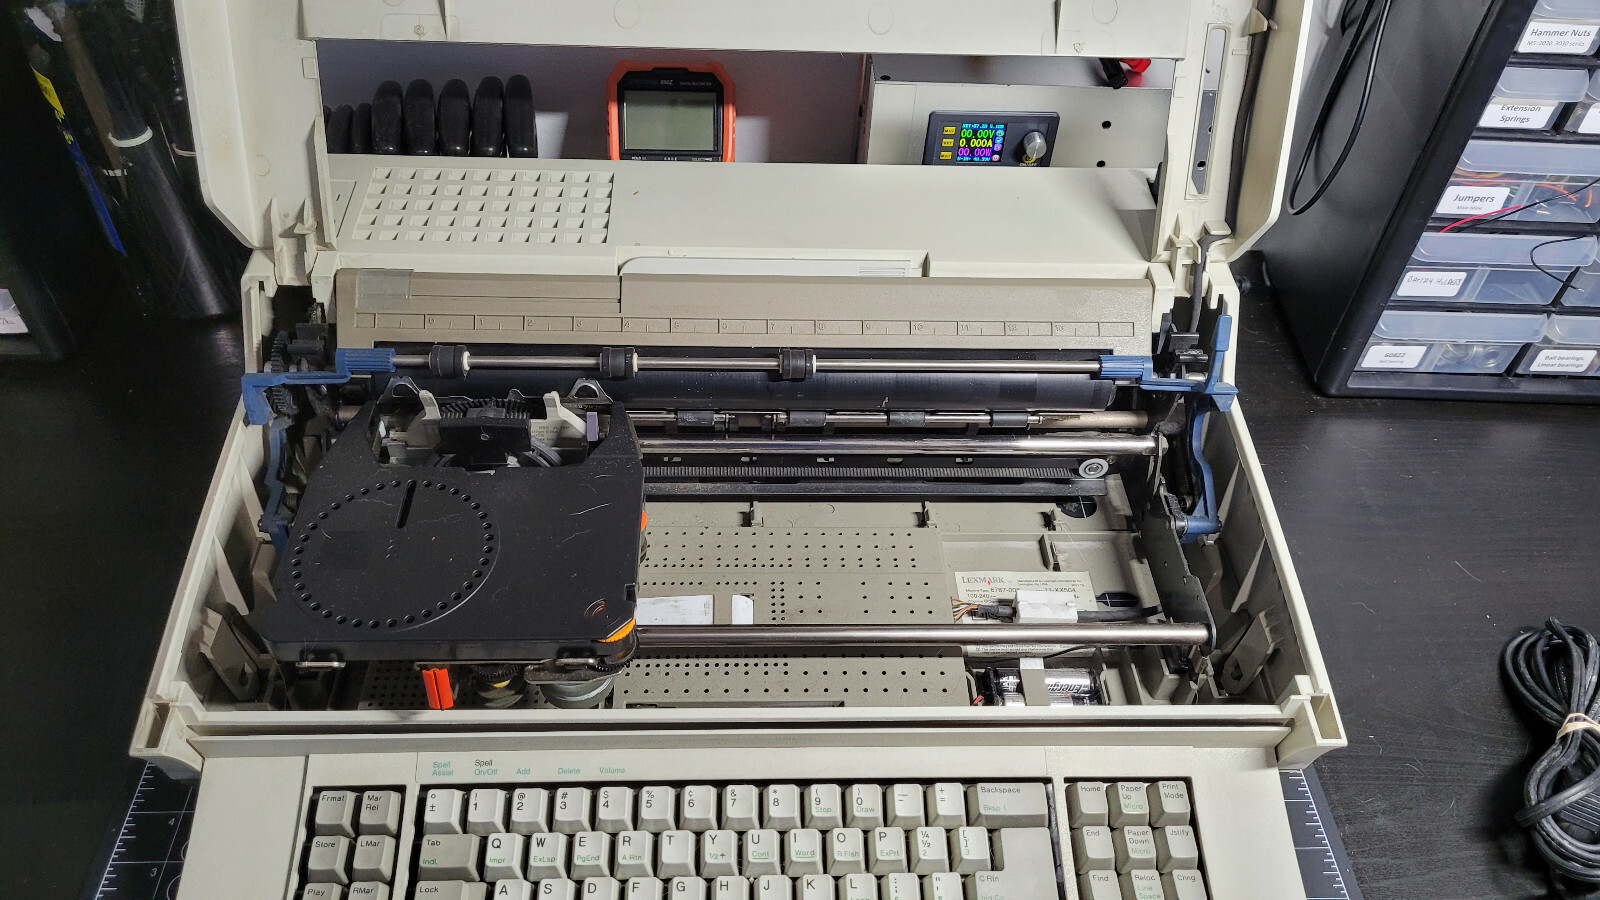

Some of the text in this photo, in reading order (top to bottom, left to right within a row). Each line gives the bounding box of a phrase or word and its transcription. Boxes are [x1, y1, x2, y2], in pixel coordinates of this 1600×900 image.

[1530, 29, 1591, 37] Hammer Nuts
[1501, 104, 1541, 112] Extension
[1500, 115, 1530, 123] Springs
[961, 129, 995, 139] 00.00V
[959, 138, 993, 148] 0.000A
[958, 148, 992, 157] 00.00W
[1453, 194, 1495, 203] Jumpers
[913, 323, 923, 331] 10
[1008, 324, 1017, 332] 12
[1054, 324, 1064, 332] 13
[962, 576, 1005, 584] LEXMARK
[432, 761, 451, 769] Spell
[474, 759, 493, 767] Spell
[474, 768, 498, 776] On/Off
[557, 767, 581, 775] Delete
[730, 789, 737, 797] &
[980, 786, 1021, 794] Backspace
[1121, 785, 1142, 793] Paper
[321, 794, 345, 802] Frmat
[517, 793, 526, 801] @
[561, 791, 568, 799] #
[603, 790, 609, 799] $
[646, 790, 654, 799] %
[602, 800, 609, 809] 4
[645, 800, 653, 809] 5
[688, 798, 695, 808] 6
[731, 798, 737, 807] 7
[772, 797, 780, 807] 8
[814, 797, 821, 806] 9
[856, 796, 863, 805] 0
[473, 802, 478, 811] 1
[516, 801, 524, 810] 2
[559, 801, 567, 810] 3
[815, 806, 832, 814] Stop
[168, 817, 175, 826] 4
[836, 832, 846, 843] O
[879, 831, 887, 841] P
[1127, 829, 1149, 837] Paper
[491, 838, 502, 849] Q
[536, 837, 546, 848] W
[579, 836, 587, 847] E
[622, 836, 631, 846] R
[666, 835, 674, 845] T
[709, 834, 717, 844] Y
[751, 834, 760, 844] U
[795, 849, 815, 857] Word
[533, 855, 556, 864] ExLsp
[576, 854, 600, 862] PgEnd
[150, 867, 157, 877] 3
[588, 883, 597, 893] D
[632, 882, 640, 893] F
[676, 881, 686, 892] G
[719, 880, 729, 891] H
[763, 880, 770, 890] J
[807, 879, 815, 889] K
[850, 878, 857, 889] L
[307, 888, 325, 896] Play
[499, 884, 508, 895] A
[544, 884, 553, 895] S
